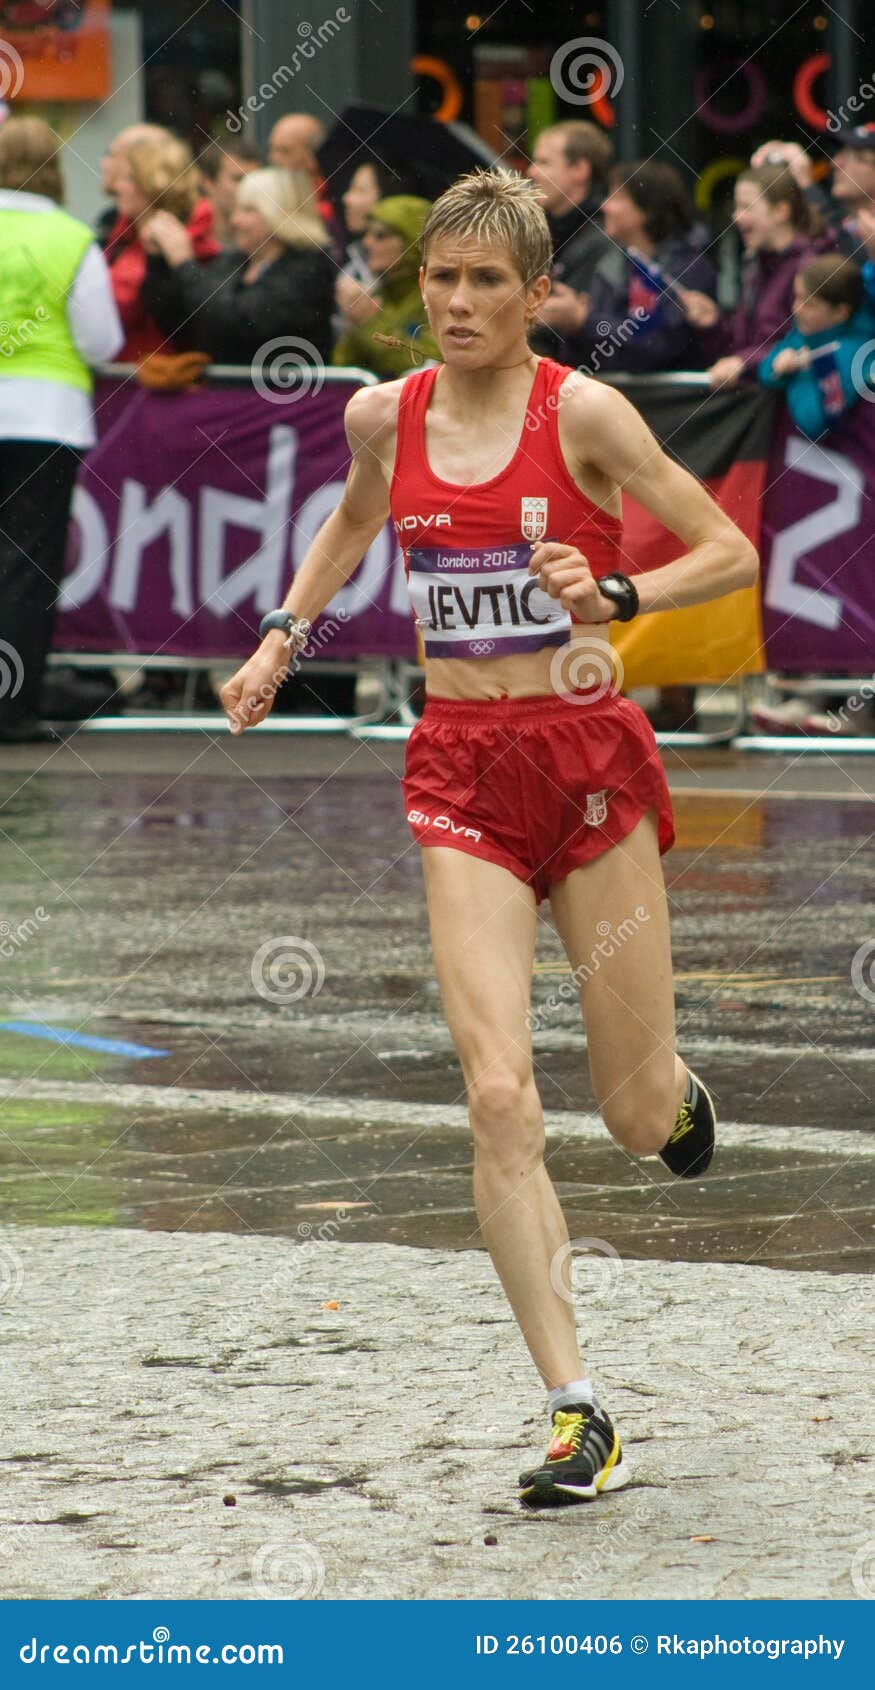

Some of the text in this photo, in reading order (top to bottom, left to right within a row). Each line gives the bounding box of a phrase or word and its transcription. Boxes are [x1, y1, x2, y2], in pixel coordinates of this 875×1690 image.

[437, 550, 517, 569] London 2012
[428, 578, 552, 631] JEVTIC
